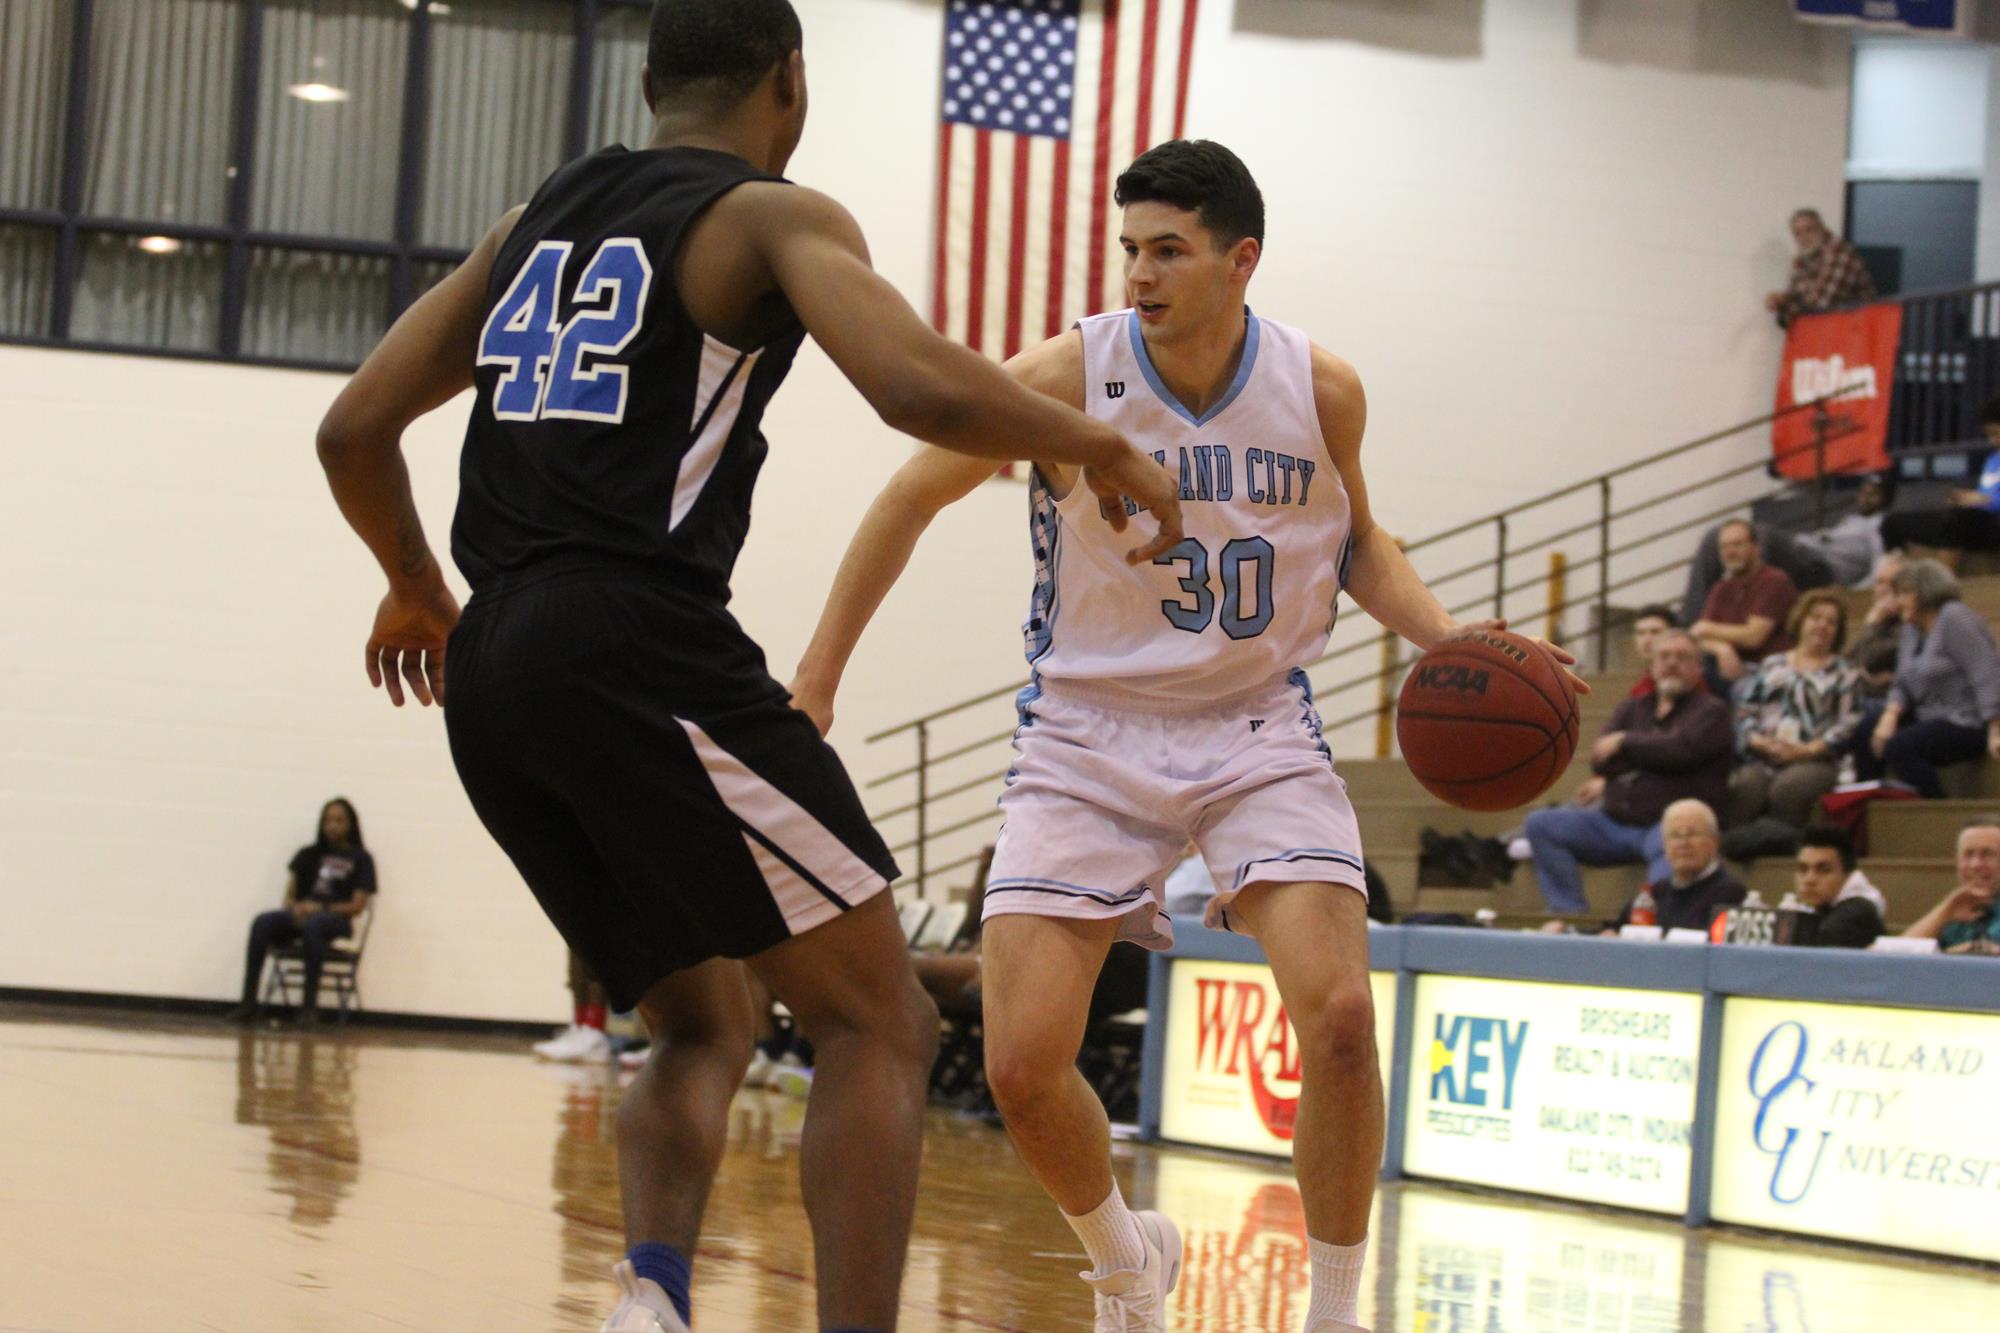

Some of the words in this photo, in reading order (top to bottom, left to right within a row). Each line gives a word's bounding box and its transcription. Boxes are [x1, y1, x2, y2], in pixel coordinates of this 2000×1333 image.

[476, 236, 653, 424] 42
[1246, 447, 1316, 506] CITY
[1152, 535, 1275, 641] 30
[1415, 665, 1491, 696] NCAA
[1725, 908, 1776, 945] POSS
[1195, 978, 1303, 1083] WRA
[1430, 1013, 1529, 1110] KEY
